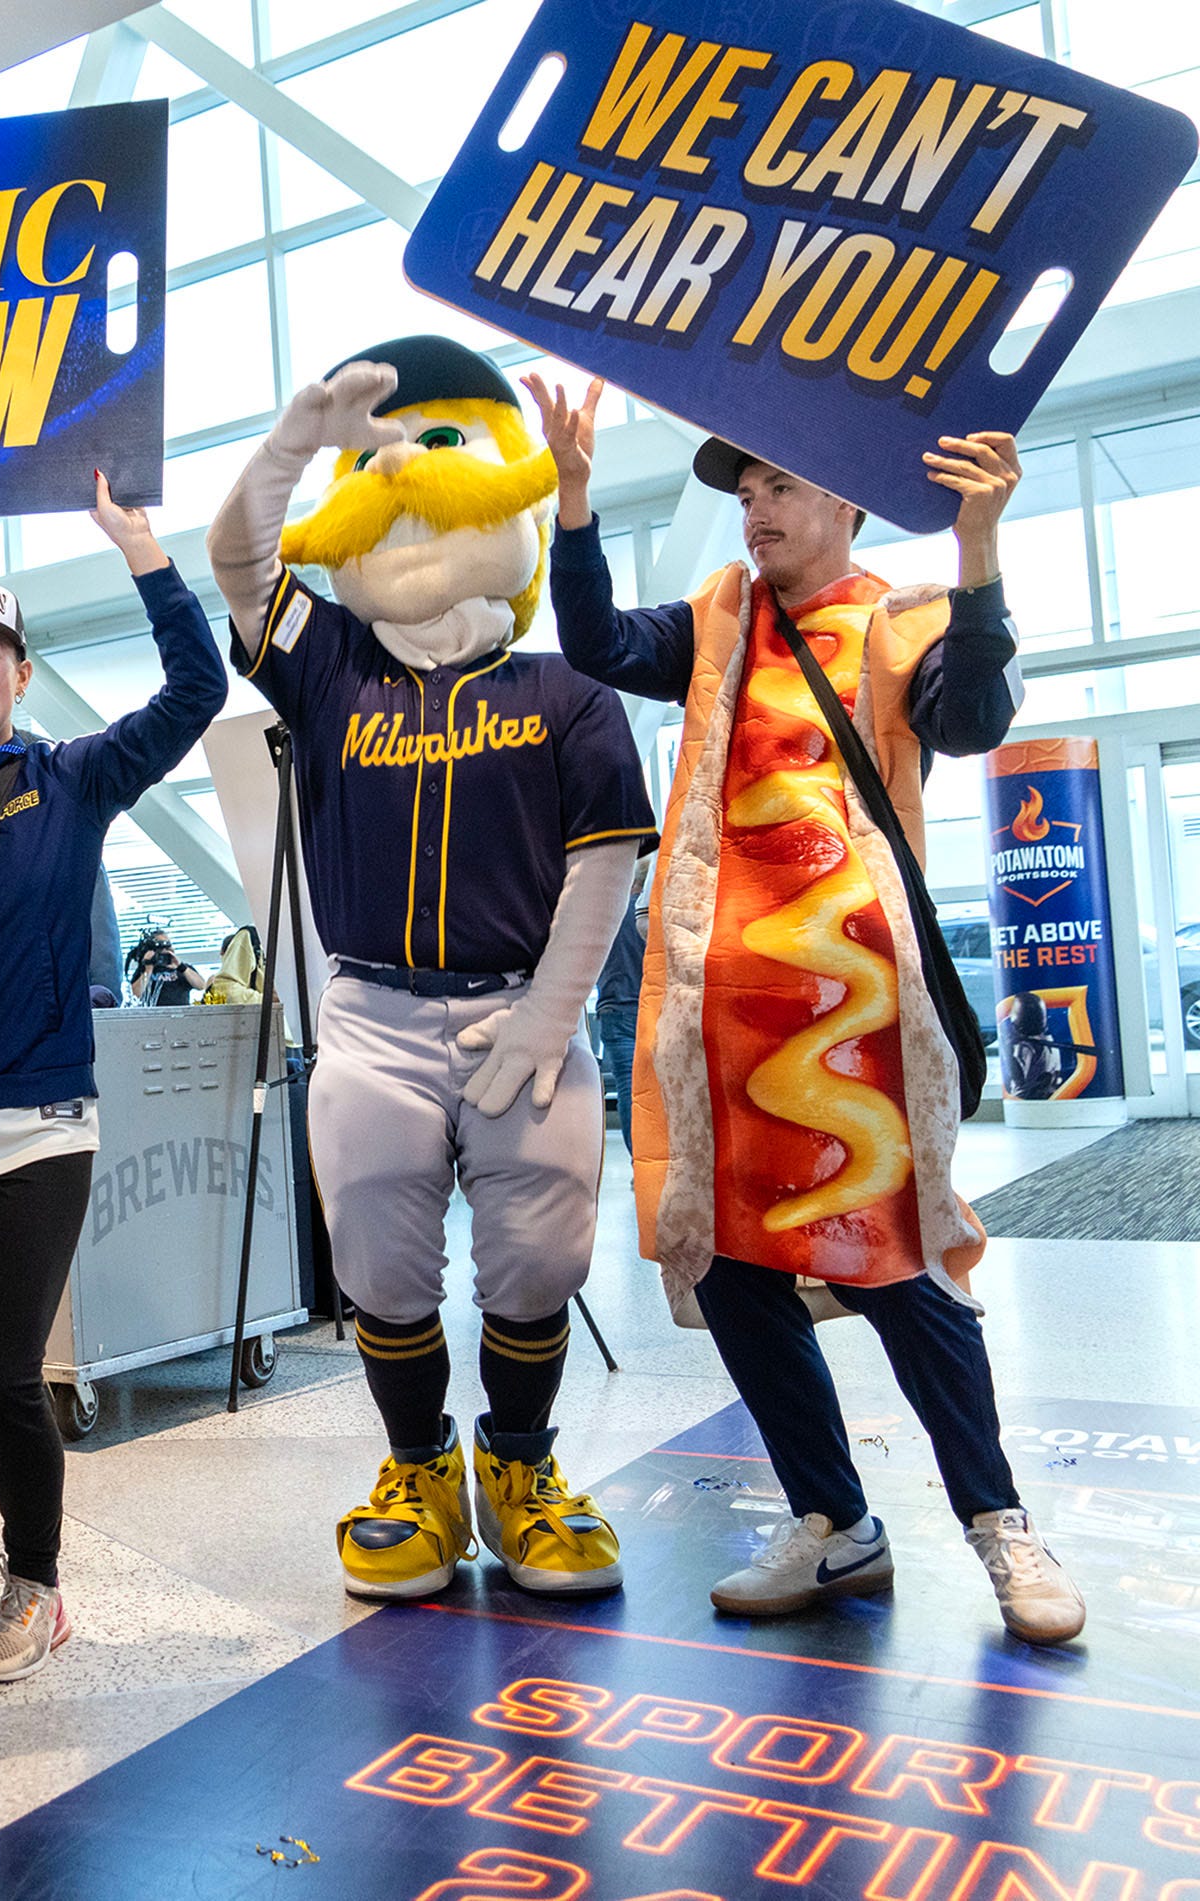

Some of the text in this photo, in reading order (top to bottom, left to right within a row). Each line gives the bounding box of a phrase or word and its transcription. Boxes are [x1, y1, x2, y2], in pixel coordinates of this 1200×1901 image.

[580, 22, 1089, 235] WE CAN'T
[473, 161, 1001, 400] HEAR YOU!!
[341, 699, 548, 770] Milwaukee
[991, 844, 1085, 877] POTAWATOMI
[997, 870, 1078, 885] SPORTSBOOK
[995, 943, 1098, 969] THE REST
[1023, 920, 1103, 944] ABOVE
[91, 1136, 275, 1247] BREWERS
[343, 1731, 1200, 1901] BETTIN
